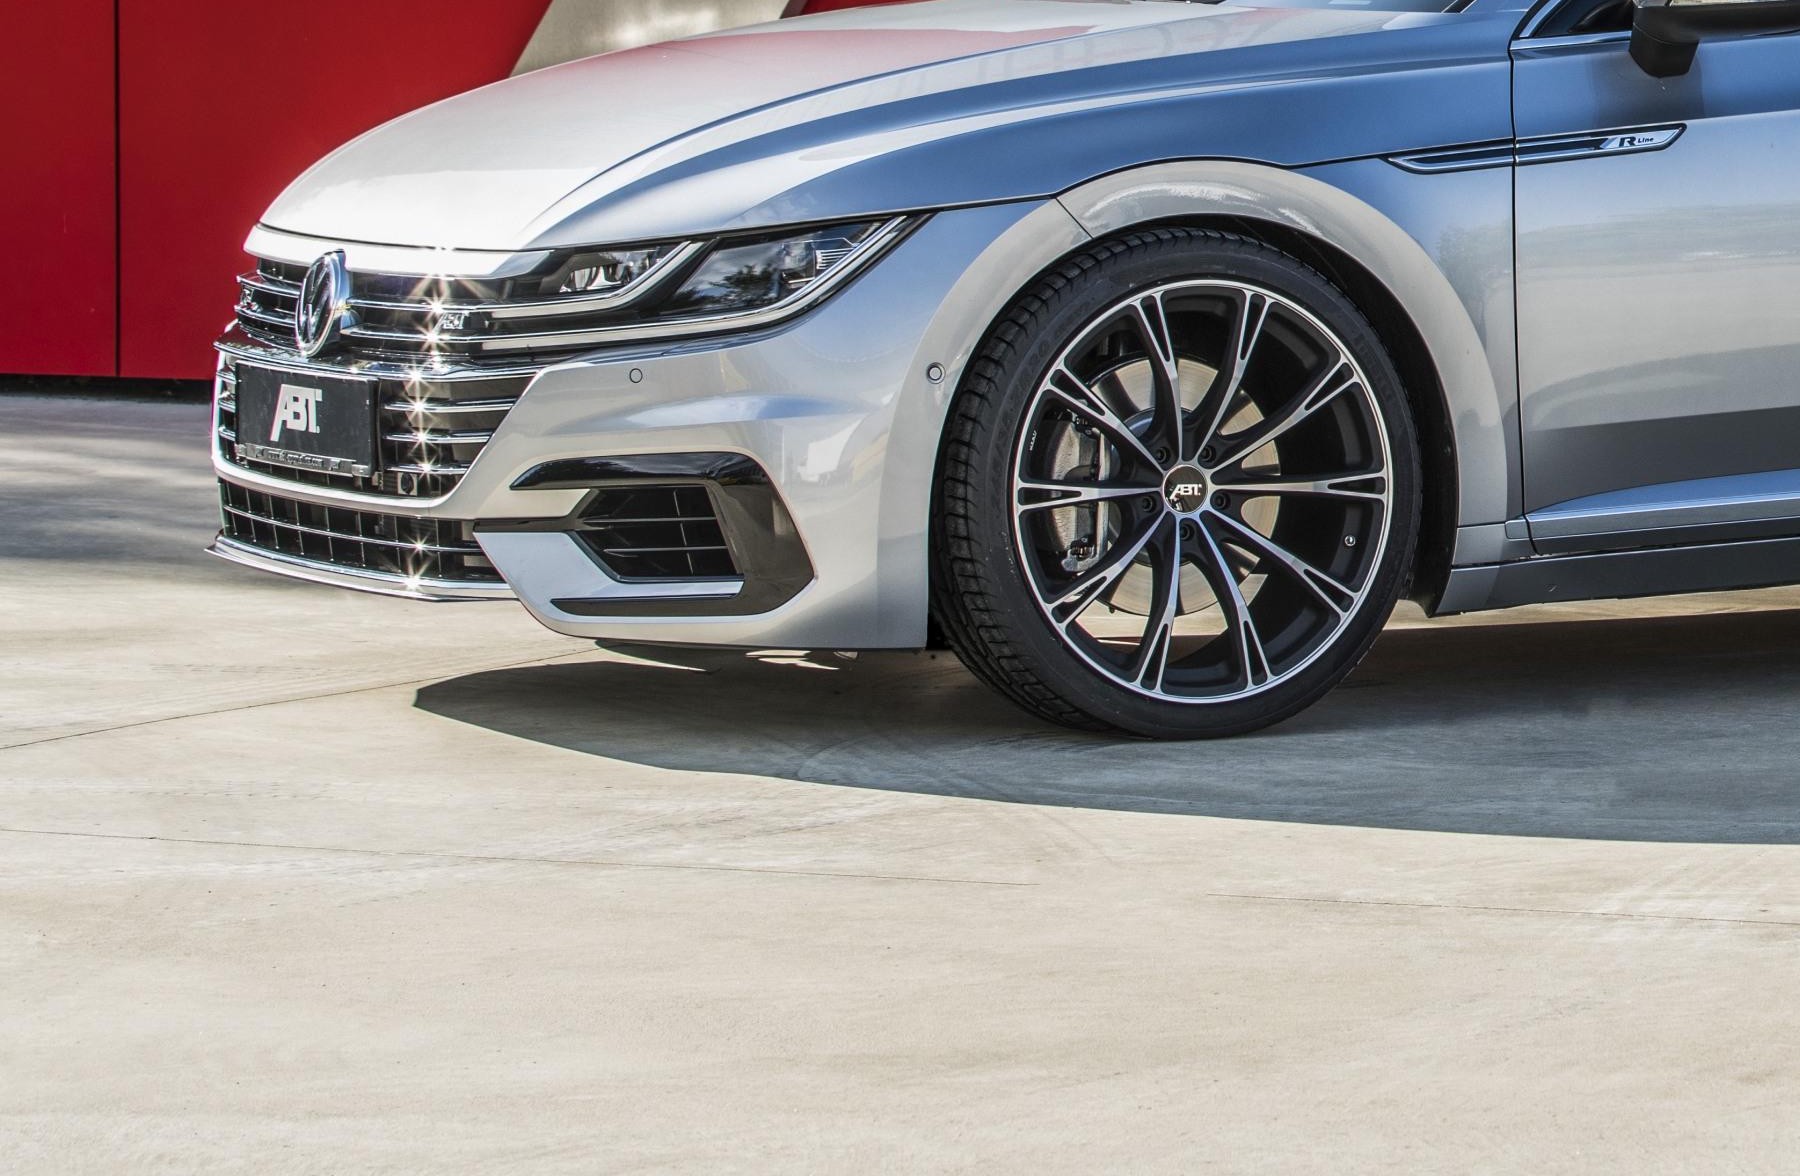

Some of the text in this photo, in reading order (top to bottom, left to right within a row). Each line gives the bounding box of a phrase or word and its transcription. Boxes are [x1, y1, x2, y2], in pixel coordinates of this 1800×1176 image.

[1619, 136, 1636, 148] R
[270, 383, 323, 442] ABT
[1169, 484, 1202, 501] ABT
